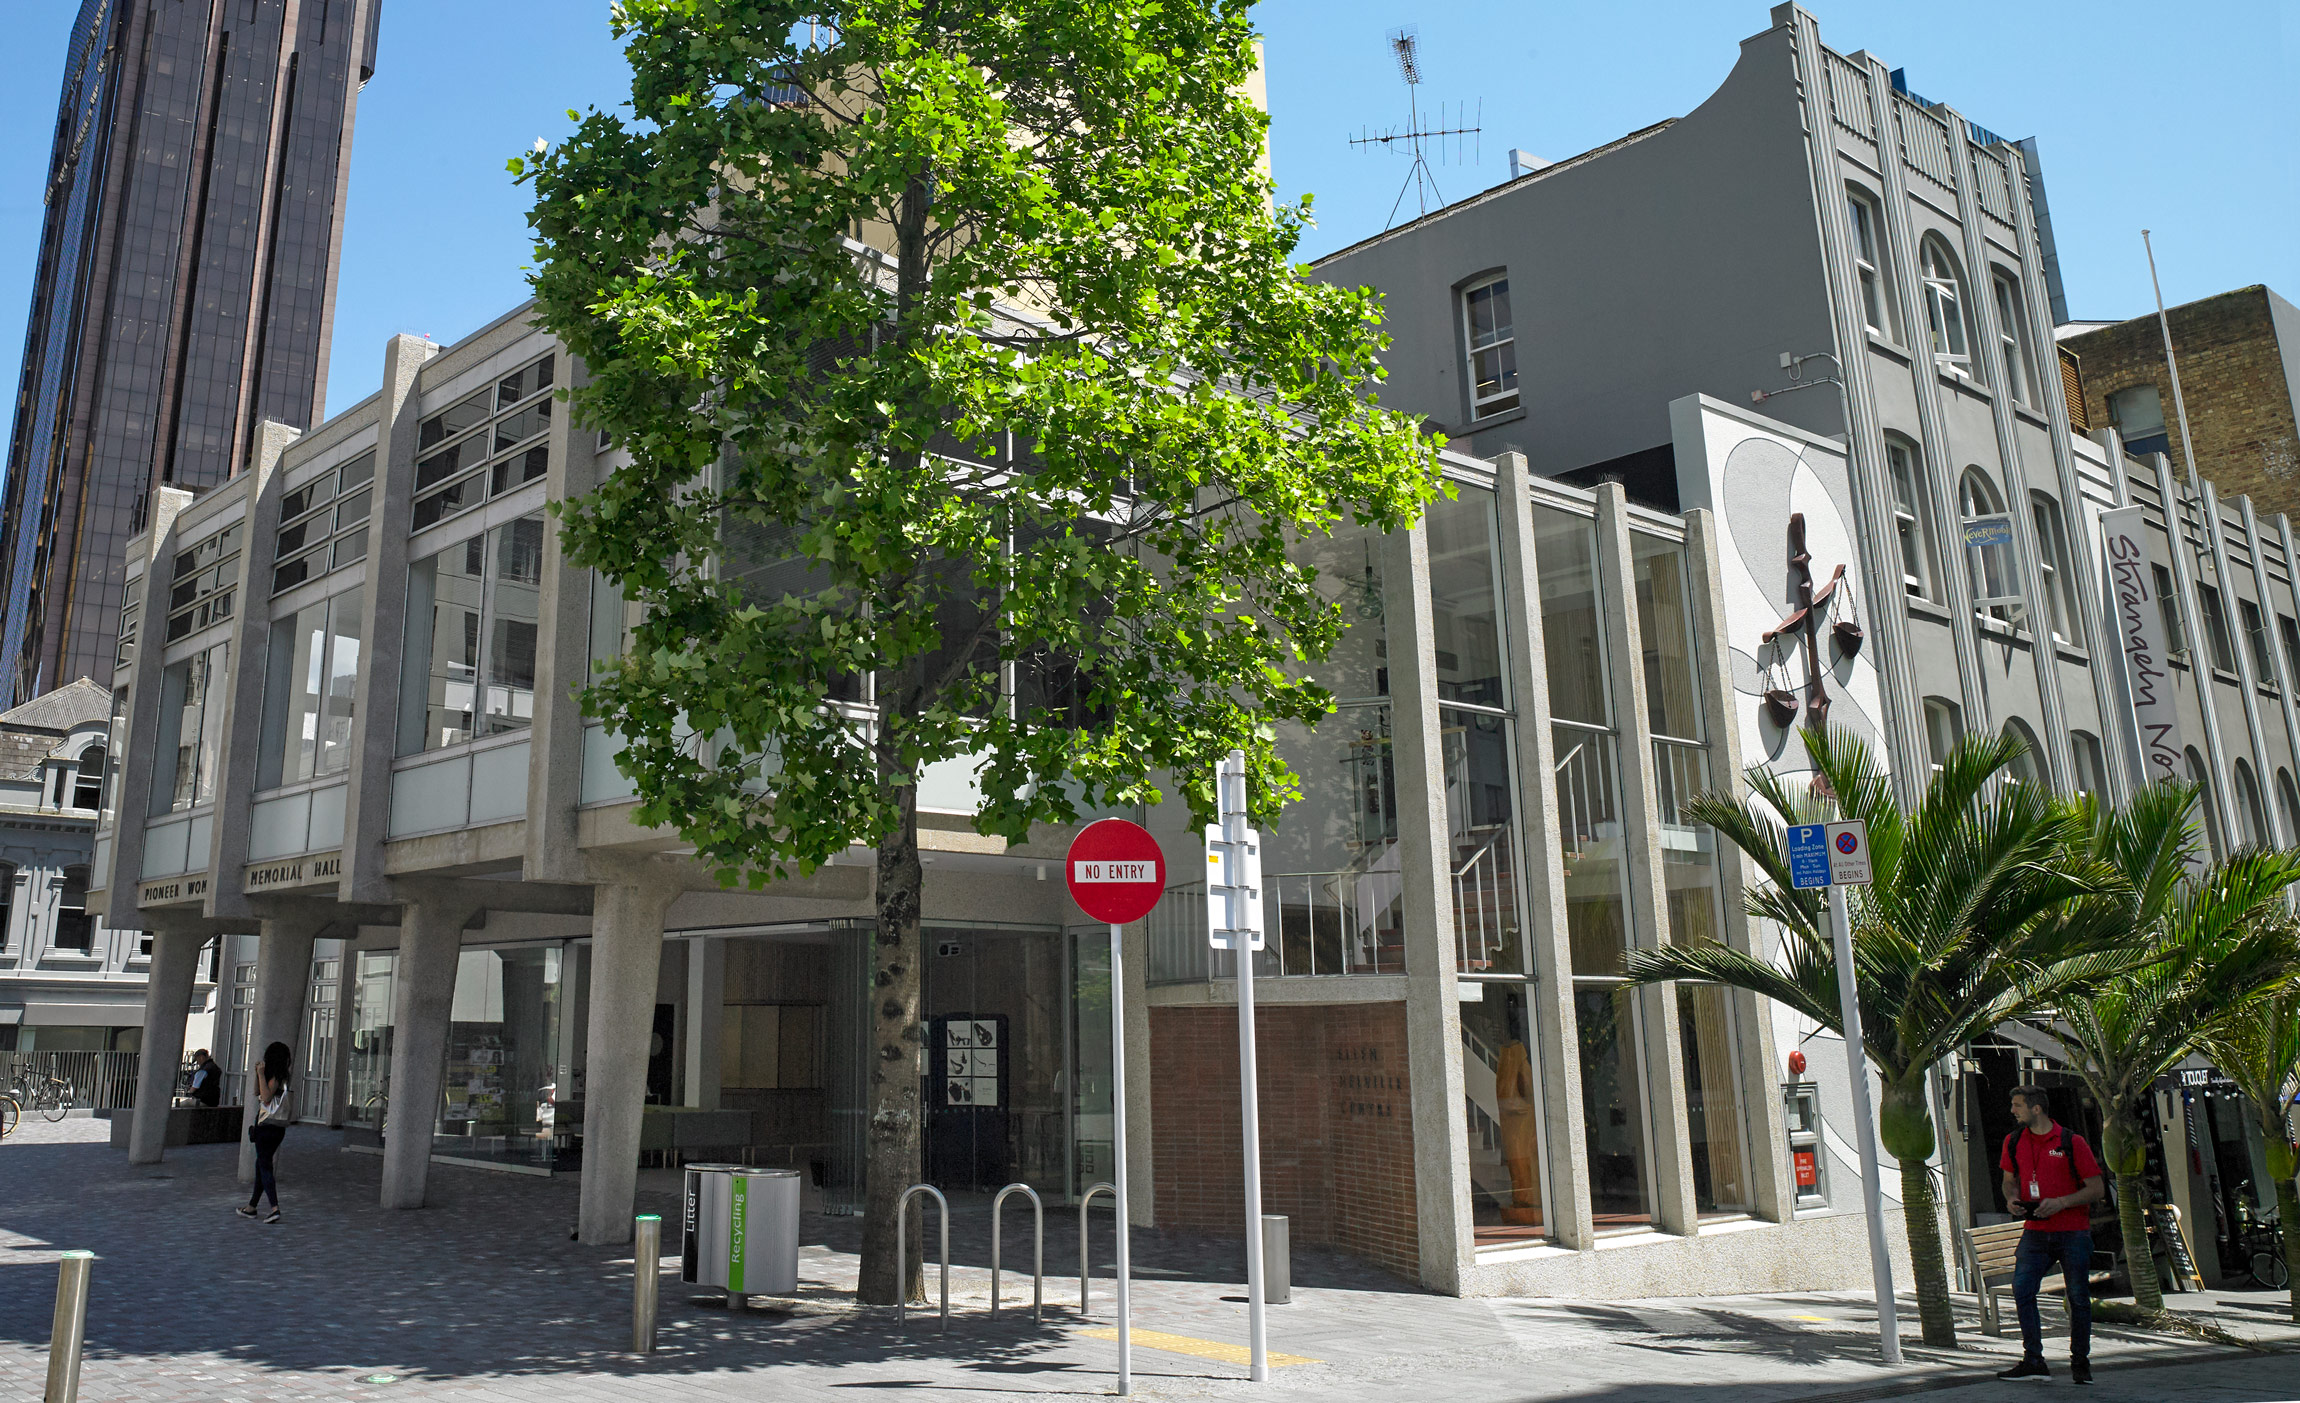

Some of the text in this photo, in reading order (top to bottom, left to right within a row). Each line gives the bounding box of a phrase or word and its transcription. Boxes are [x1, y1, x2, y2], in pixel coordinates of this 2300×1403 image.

[2108, 534, 2165, 707] Strangely
[1800, 828, 1813, 844] P
[1791, 844, 1811, 852] Loading
[250, 859, 342, 886] MEMORIAL HALL
[1085, 864, 1145, 879] NO ENTRY
[1800, 875, 1825, 886] BEGINS
[1838, 870, 1864, 880] BEGINS
[144, 879, 208, 901] PIONEER WOM
[686, 1189, 696, 1232] Litter
[731, 1193, 745, 1263] Recycling
